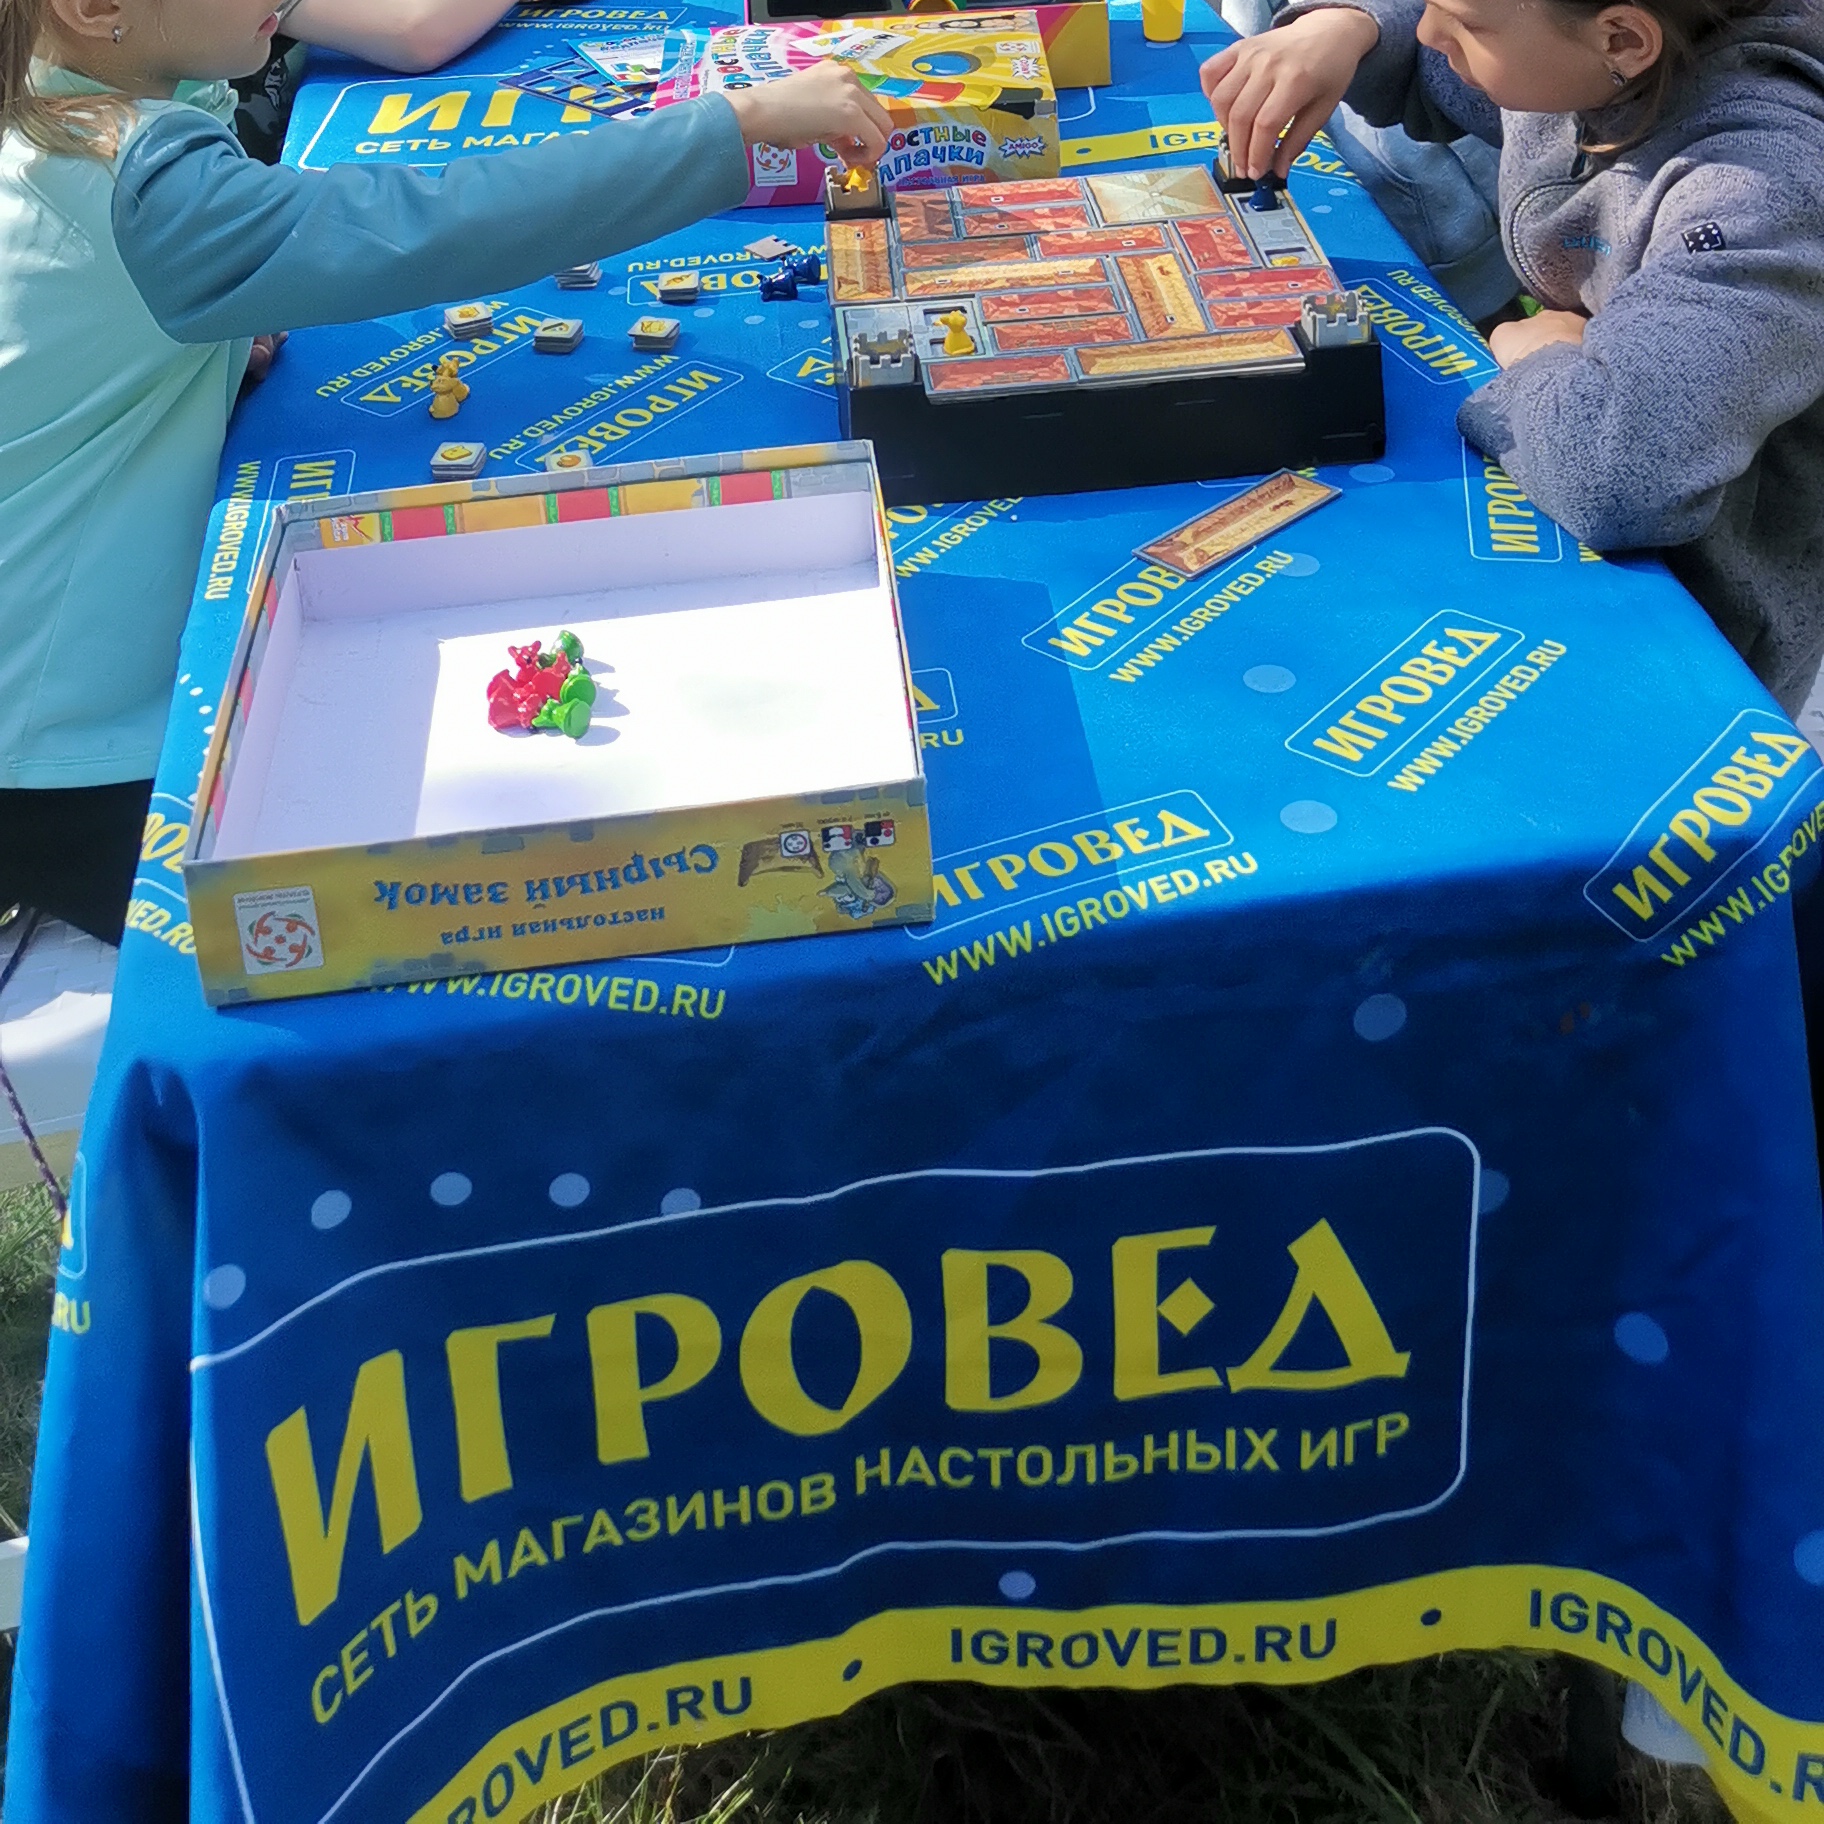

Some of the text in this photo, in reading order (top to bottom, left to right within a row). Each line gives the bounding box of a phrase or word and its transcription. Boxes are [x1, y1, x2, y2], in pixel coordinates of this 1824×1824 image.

[355, 139, 451, 154] СЕТЬ
[1008, 141, 1039, 152] AMIGO
[488, 354, 680, 460] WWW.IGROVED.RU
[204, 460, 262, 600] WWW.IGROVED.RU
[1047, 564, 1187, 657] ИГРОВ
[1108, 549, 1295, 683] WWW.IGROVED.RU
[1312, 627, 1502, 762] ИГРОВЕД
[1386, 638, 1568, 793] WWW.IGROVED.RU
[374, 843, 720, 911] Сырный замок
[1611, 731, 1812, 922] ИГРОВЕД
[441, 906, 666, 947] настольная игра
[922, 851, 1260, 986] WWW.IGROVED.RU
[264, 1217, 1411, 1627] ИГРОВЕД
[310, 1412, 1411, 1725] СЕТЬ МАГАЗИНОВ НАСТОЛЬНЫХ ИГР
[949, 1619, 1339, 1668] IGROVED.RU
[1529, 1588, 1824, 1804] IGROVED.R
[447, 1676, 753, 1824] ROVED.RU
